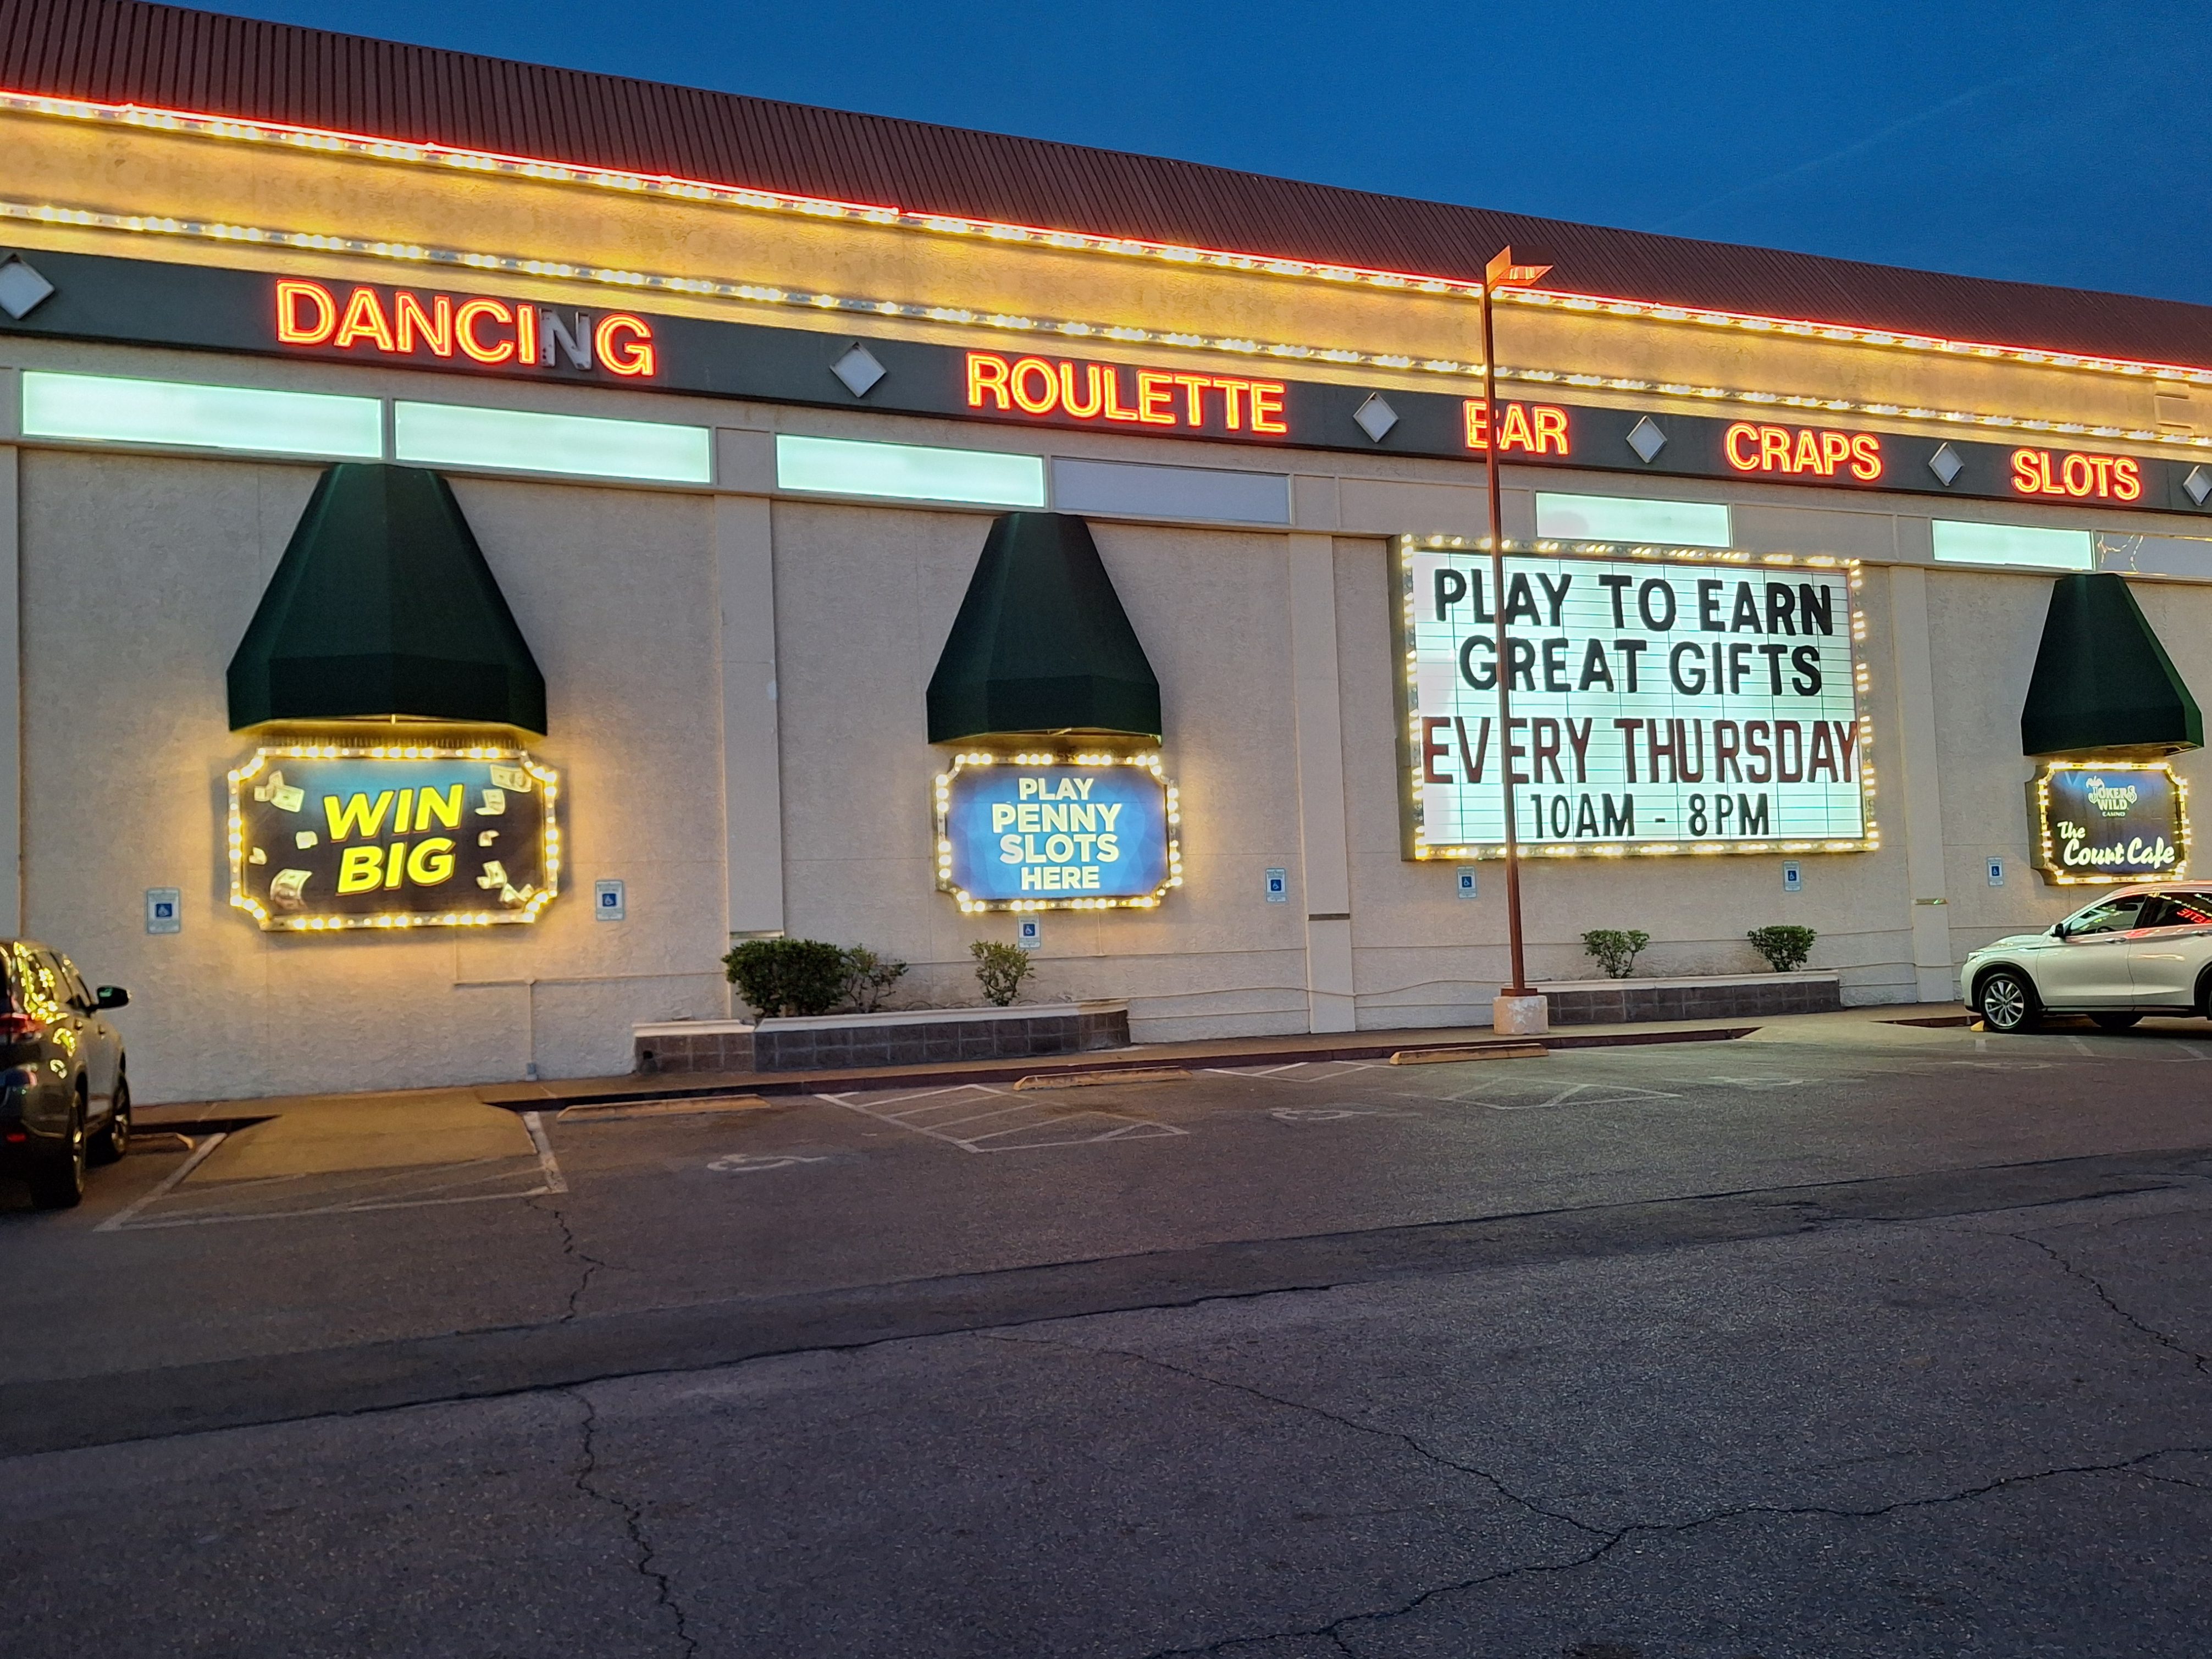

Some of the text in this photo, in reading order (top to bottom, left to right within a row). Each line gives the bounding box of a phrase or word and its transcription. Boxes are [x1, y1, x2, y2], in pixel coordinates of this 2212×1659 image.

[276, 278, 655, 377] DANCING
[966, 351, 1287, 433] ROULETTE
[1463, 399, 1570, 455] BAR
[1724, 422, 1882, 480] CRAPS
[2010, 449, 2141, 501] SLOTS
[1434, 568, 1833, 636] PLAY TO EARN
[1459, 635, 1823, 696] GREAT GIFTS
[1422, 716, 1857, 785] EVERY THURSDAY
[323, 784, 464, 843] WIN
[1019, 777, 1094, 801] PLAY
[1530, 793, 1636, 839] 10AM
[1688, 793, 1770, 837] 8PM
[2097, 799, 2128, 810] WILD
[992, 803, 1122, 833] PENNY
[2057, 821, 2086, 839] The
[336, 837, 456, 896] BIG
[999, 834, 1119, 865] SLOTS
[2127, 836, 2175, 869] Cafe
[1021, 866, 1100, 891] HERE
